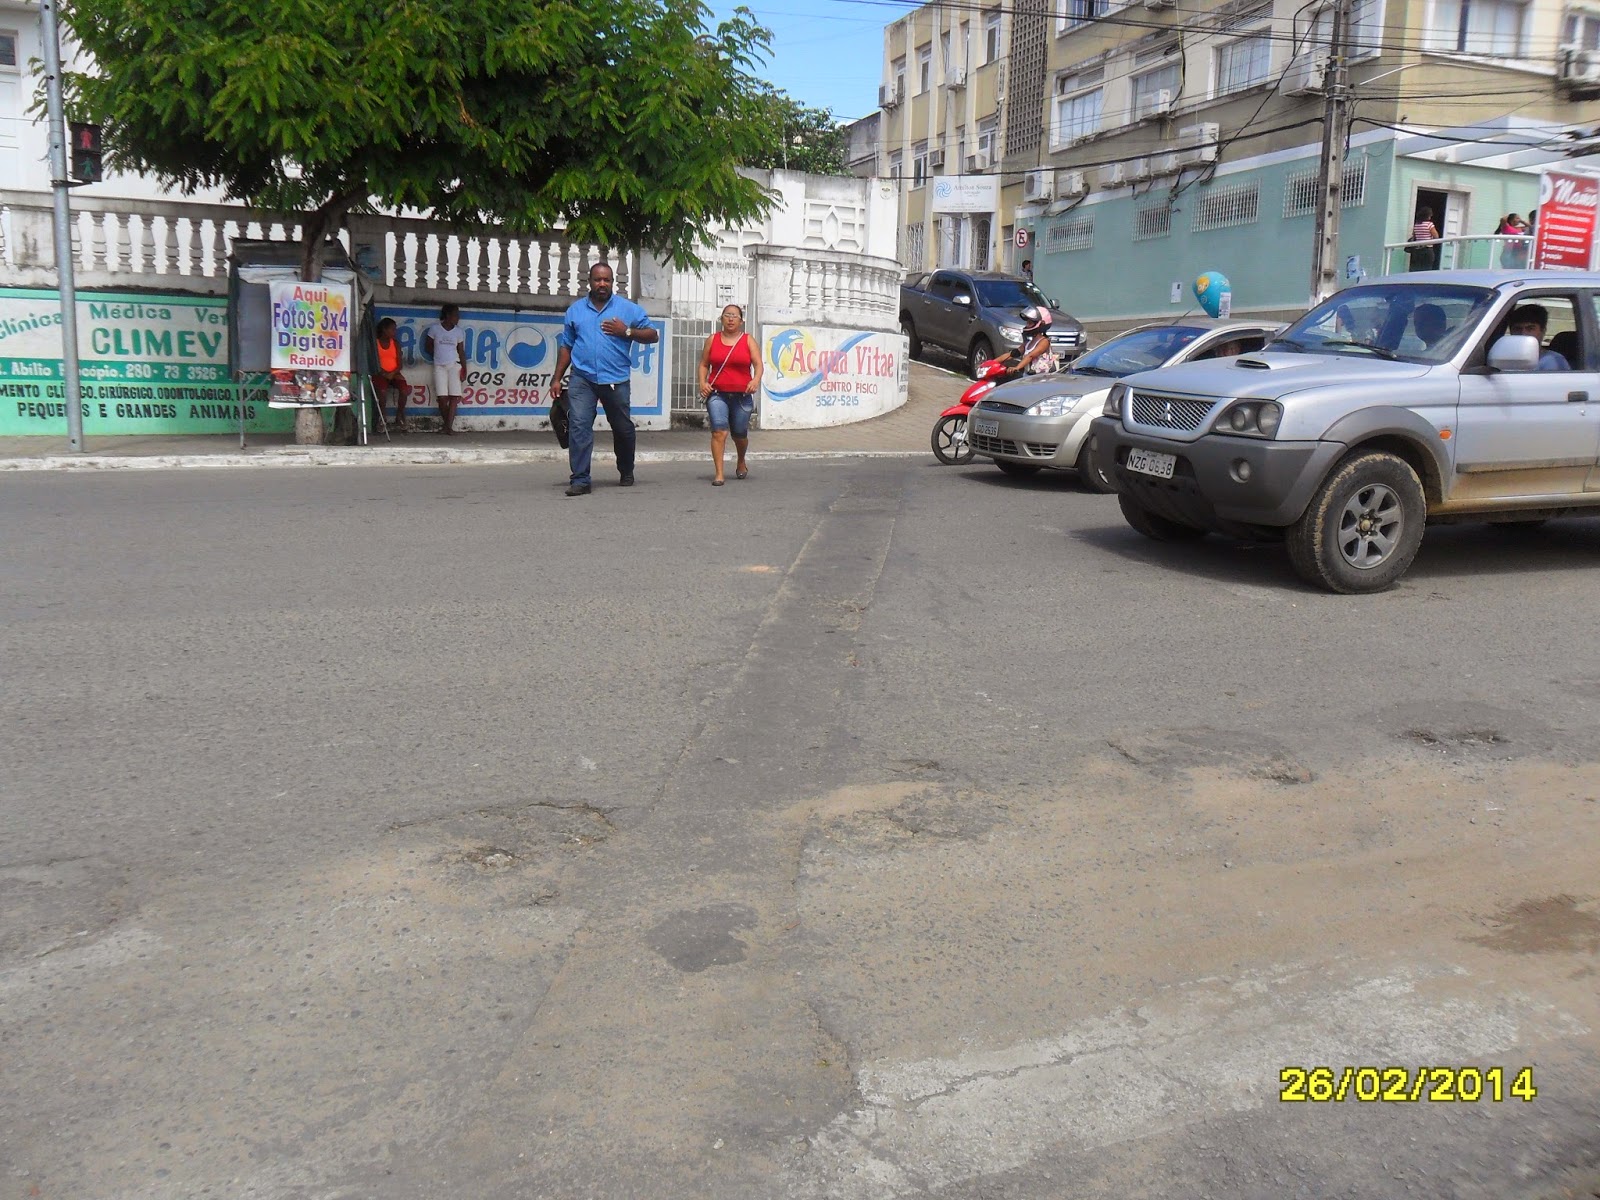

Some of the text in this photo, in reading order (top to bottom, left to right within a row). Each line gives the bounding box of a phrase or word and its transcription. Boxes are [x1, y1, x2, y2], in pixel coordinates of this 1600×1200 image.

[293, 286, 328, 305] Aqui
[89, 302, 172, 320] Médica
[273, 303, 348, 332] Fotos 3x4
[92, 327, 222, 358] CLIMEV
[278, 331, 343, 352] Digital
[289, 353, 334, 367] Rápido
[788, 343, 849, 380] Acqua
[855, 346, 894, 378] Vitae
[164, 365, 180, 379] 73
[820, 381, 852, 393] CENTRO
[17, 402, 256, 420] PEQUES E GRANDES ANIMAIS
